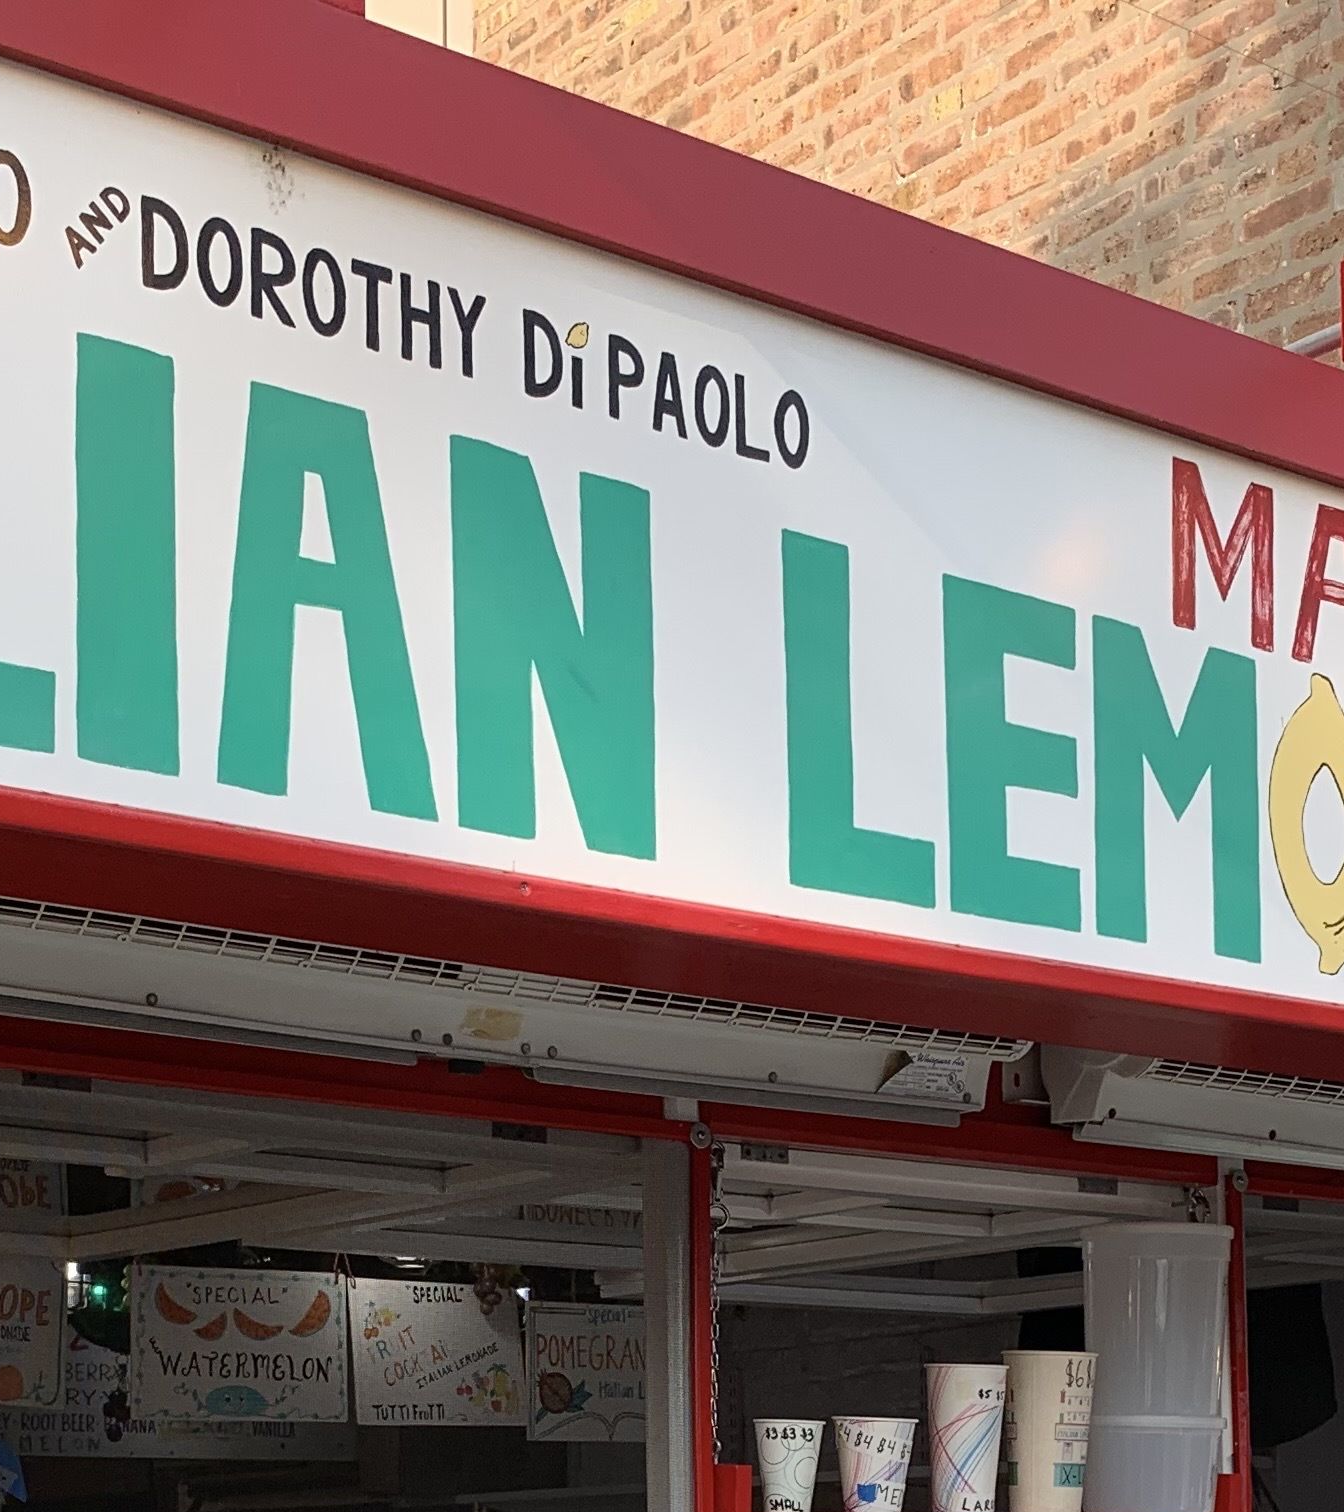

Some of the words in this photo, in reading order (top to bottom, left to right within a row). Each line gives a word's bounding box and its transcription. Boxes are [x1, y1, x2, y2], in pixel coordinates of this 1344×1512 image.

[64, 186, 131, 269] AND
[140, 195, 486, 378] DOROTHY
[606, 333, 810, 469] PAOLO
[159, 1352, 334, 1384] WATERMELON
[977, 1387, 993, 1400] $5
[766, 1427, 778, 1440] $3
[781, 1426, 796, 1440] $3
[800, 1427, 814, 1442] $3
[853, 1430, 874, 1450] $4
[877, 1437, 897, 1455] $4
[769, 1498, 804, 1512] SMALL
